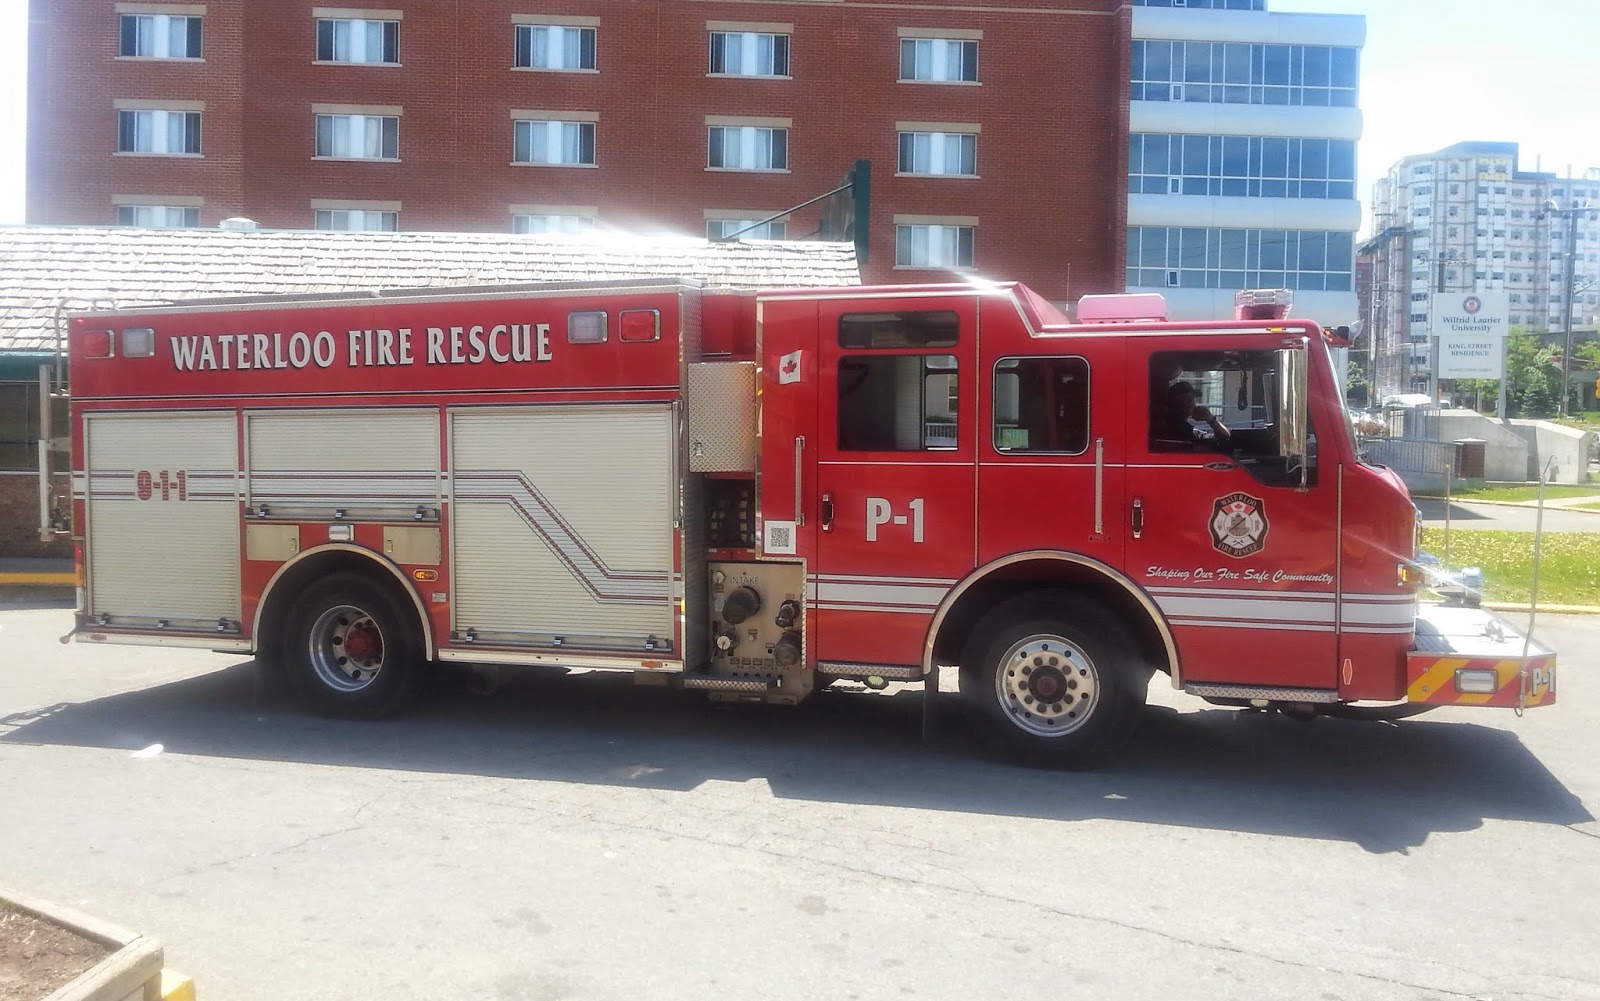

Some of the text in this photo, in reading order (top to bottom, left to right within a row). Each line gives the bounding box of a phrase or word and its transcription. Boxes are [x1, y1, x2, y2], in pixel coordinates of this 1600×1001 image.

[1442, 316, 1501, 324] Wilfrid Laurier
[1451, 324, 1492, 334] University
[170, 322, 553, 372] WATERLOO FIRE RESCUE
[137, 470, 186, 501] 9-1-1
[1221, 494, 1257, 507] WATERLOO
[866, 497, 924, 543] P-1
[1217, 543, 1258, 556] FIRE RESCUE
[729, 576, 760, 585] INTAKE
[1146, 566, 1334, 584] Shaping Our Fire Safe Community
[1531, 666, 1556, 697] P-1
